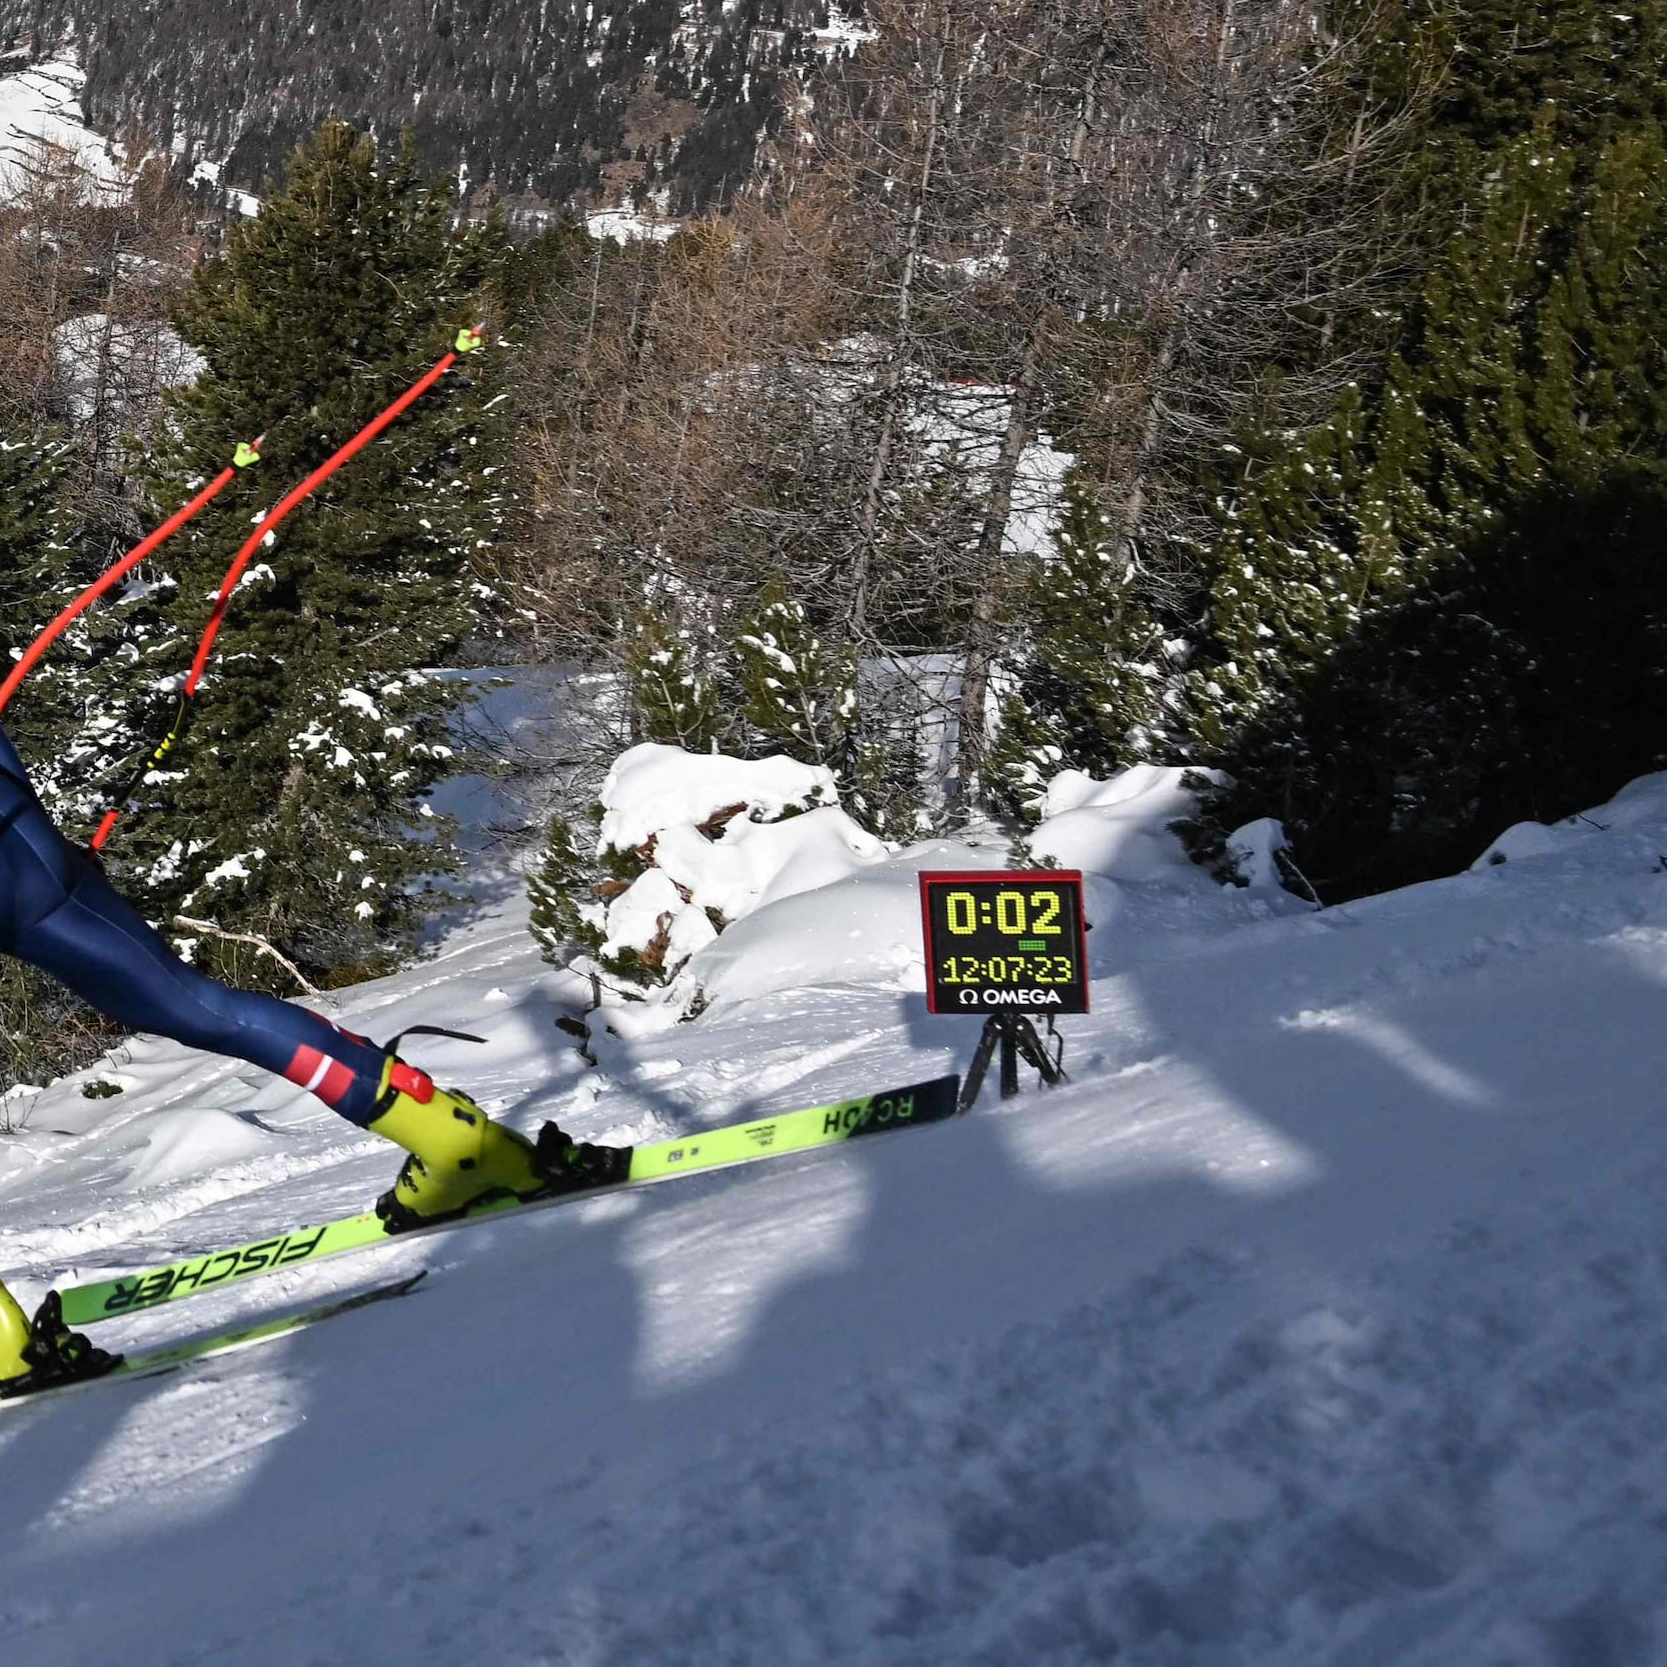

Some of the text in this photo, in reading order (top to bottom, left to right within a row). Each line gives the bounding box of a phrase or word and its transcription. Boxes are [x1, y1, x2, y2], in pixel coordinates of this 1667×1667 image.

[946, 891, 1062, 935] 0:02
[942, 956, 1072, 983] 12:07:23
[982, 988, 1063, 1005] OMEGA
[104, 1226, 328, 1311] FISCHER
